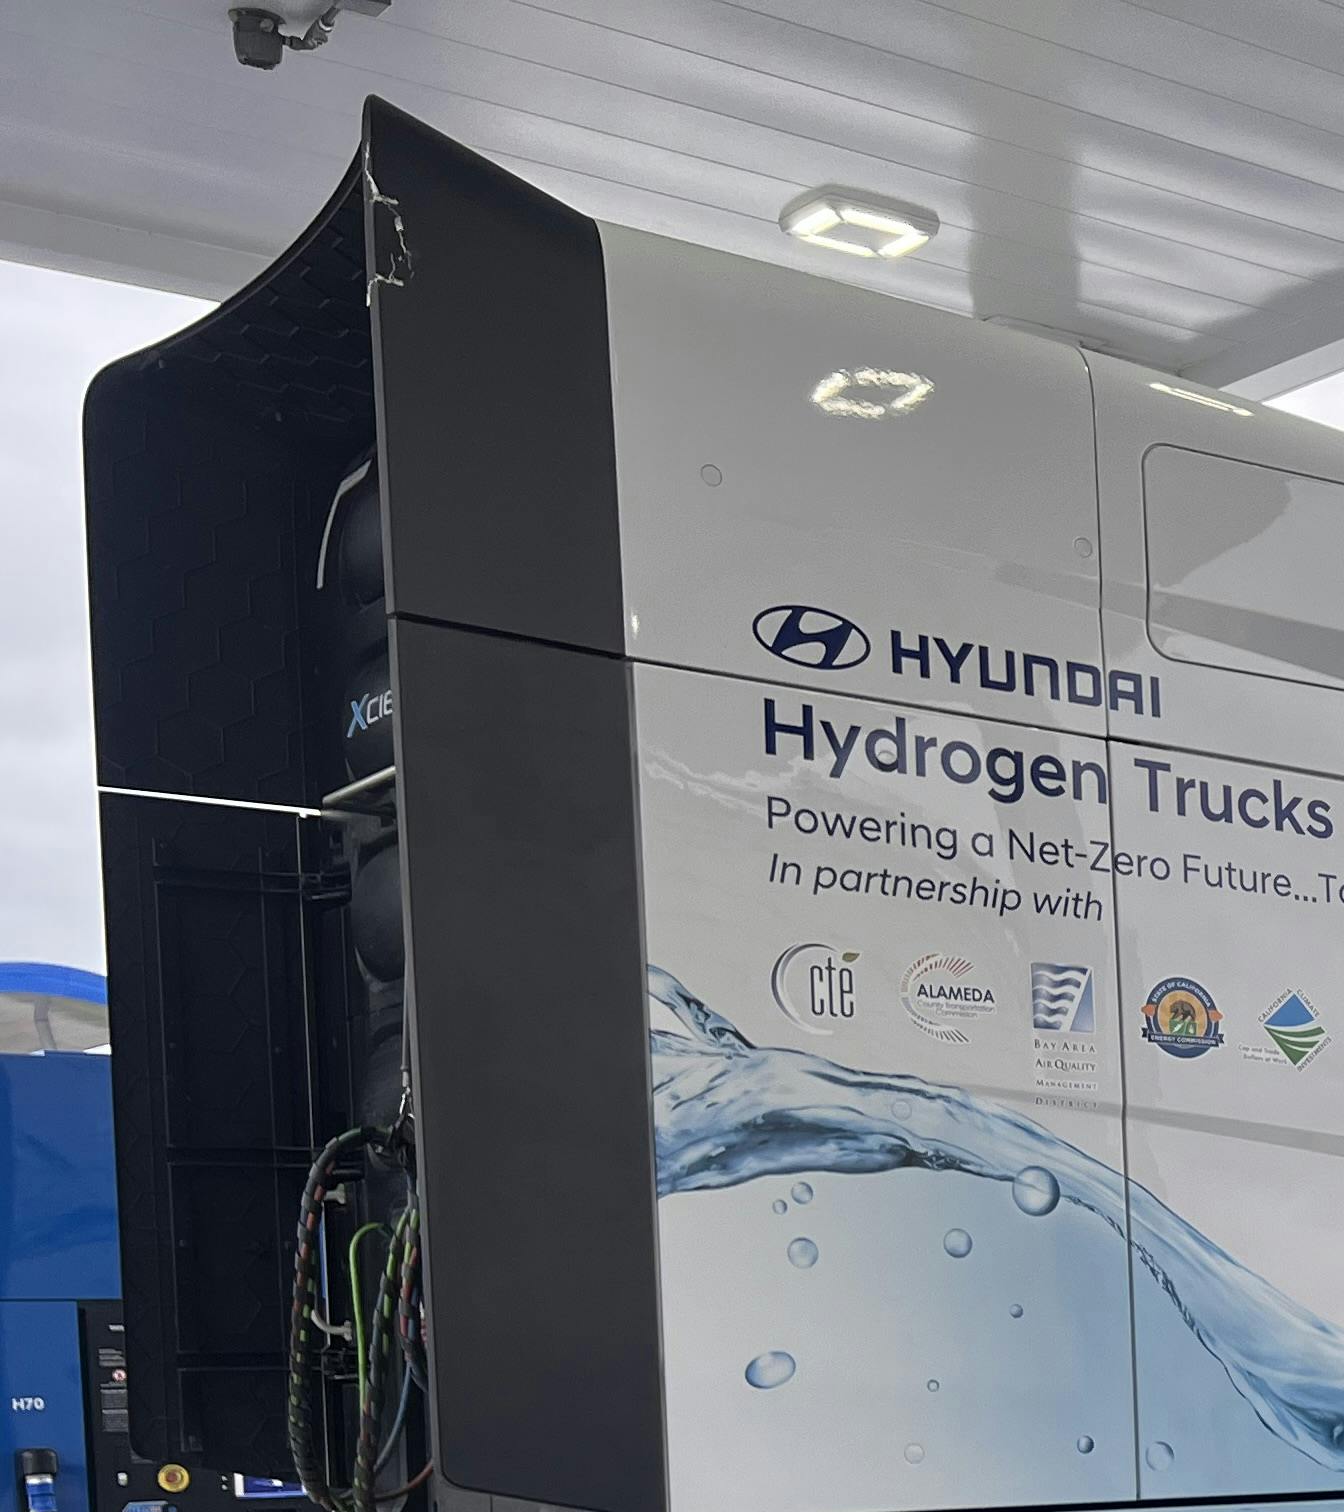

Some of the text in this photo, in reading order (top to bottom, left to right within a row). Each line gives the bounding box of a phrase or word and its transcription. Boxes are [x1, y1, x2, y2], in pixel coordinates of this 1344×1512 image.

[890, 629, 1161, 718] HYUNDAI
[763, 697, 1335, 839] Hydrogen Trucks
[767, 796, 958, 860] Powering
[971, 832, 994, 857] a
[1008, 829, 1170, 881] Net-Zero
[768, 854, 1102, 921] In partnership with
[917, 984, 995, 1004] ALAMEDA
[1257, 988, 1321, 1023] CALIFORNIA CLIMATE
[11, 1397, 46, 1412] H70
